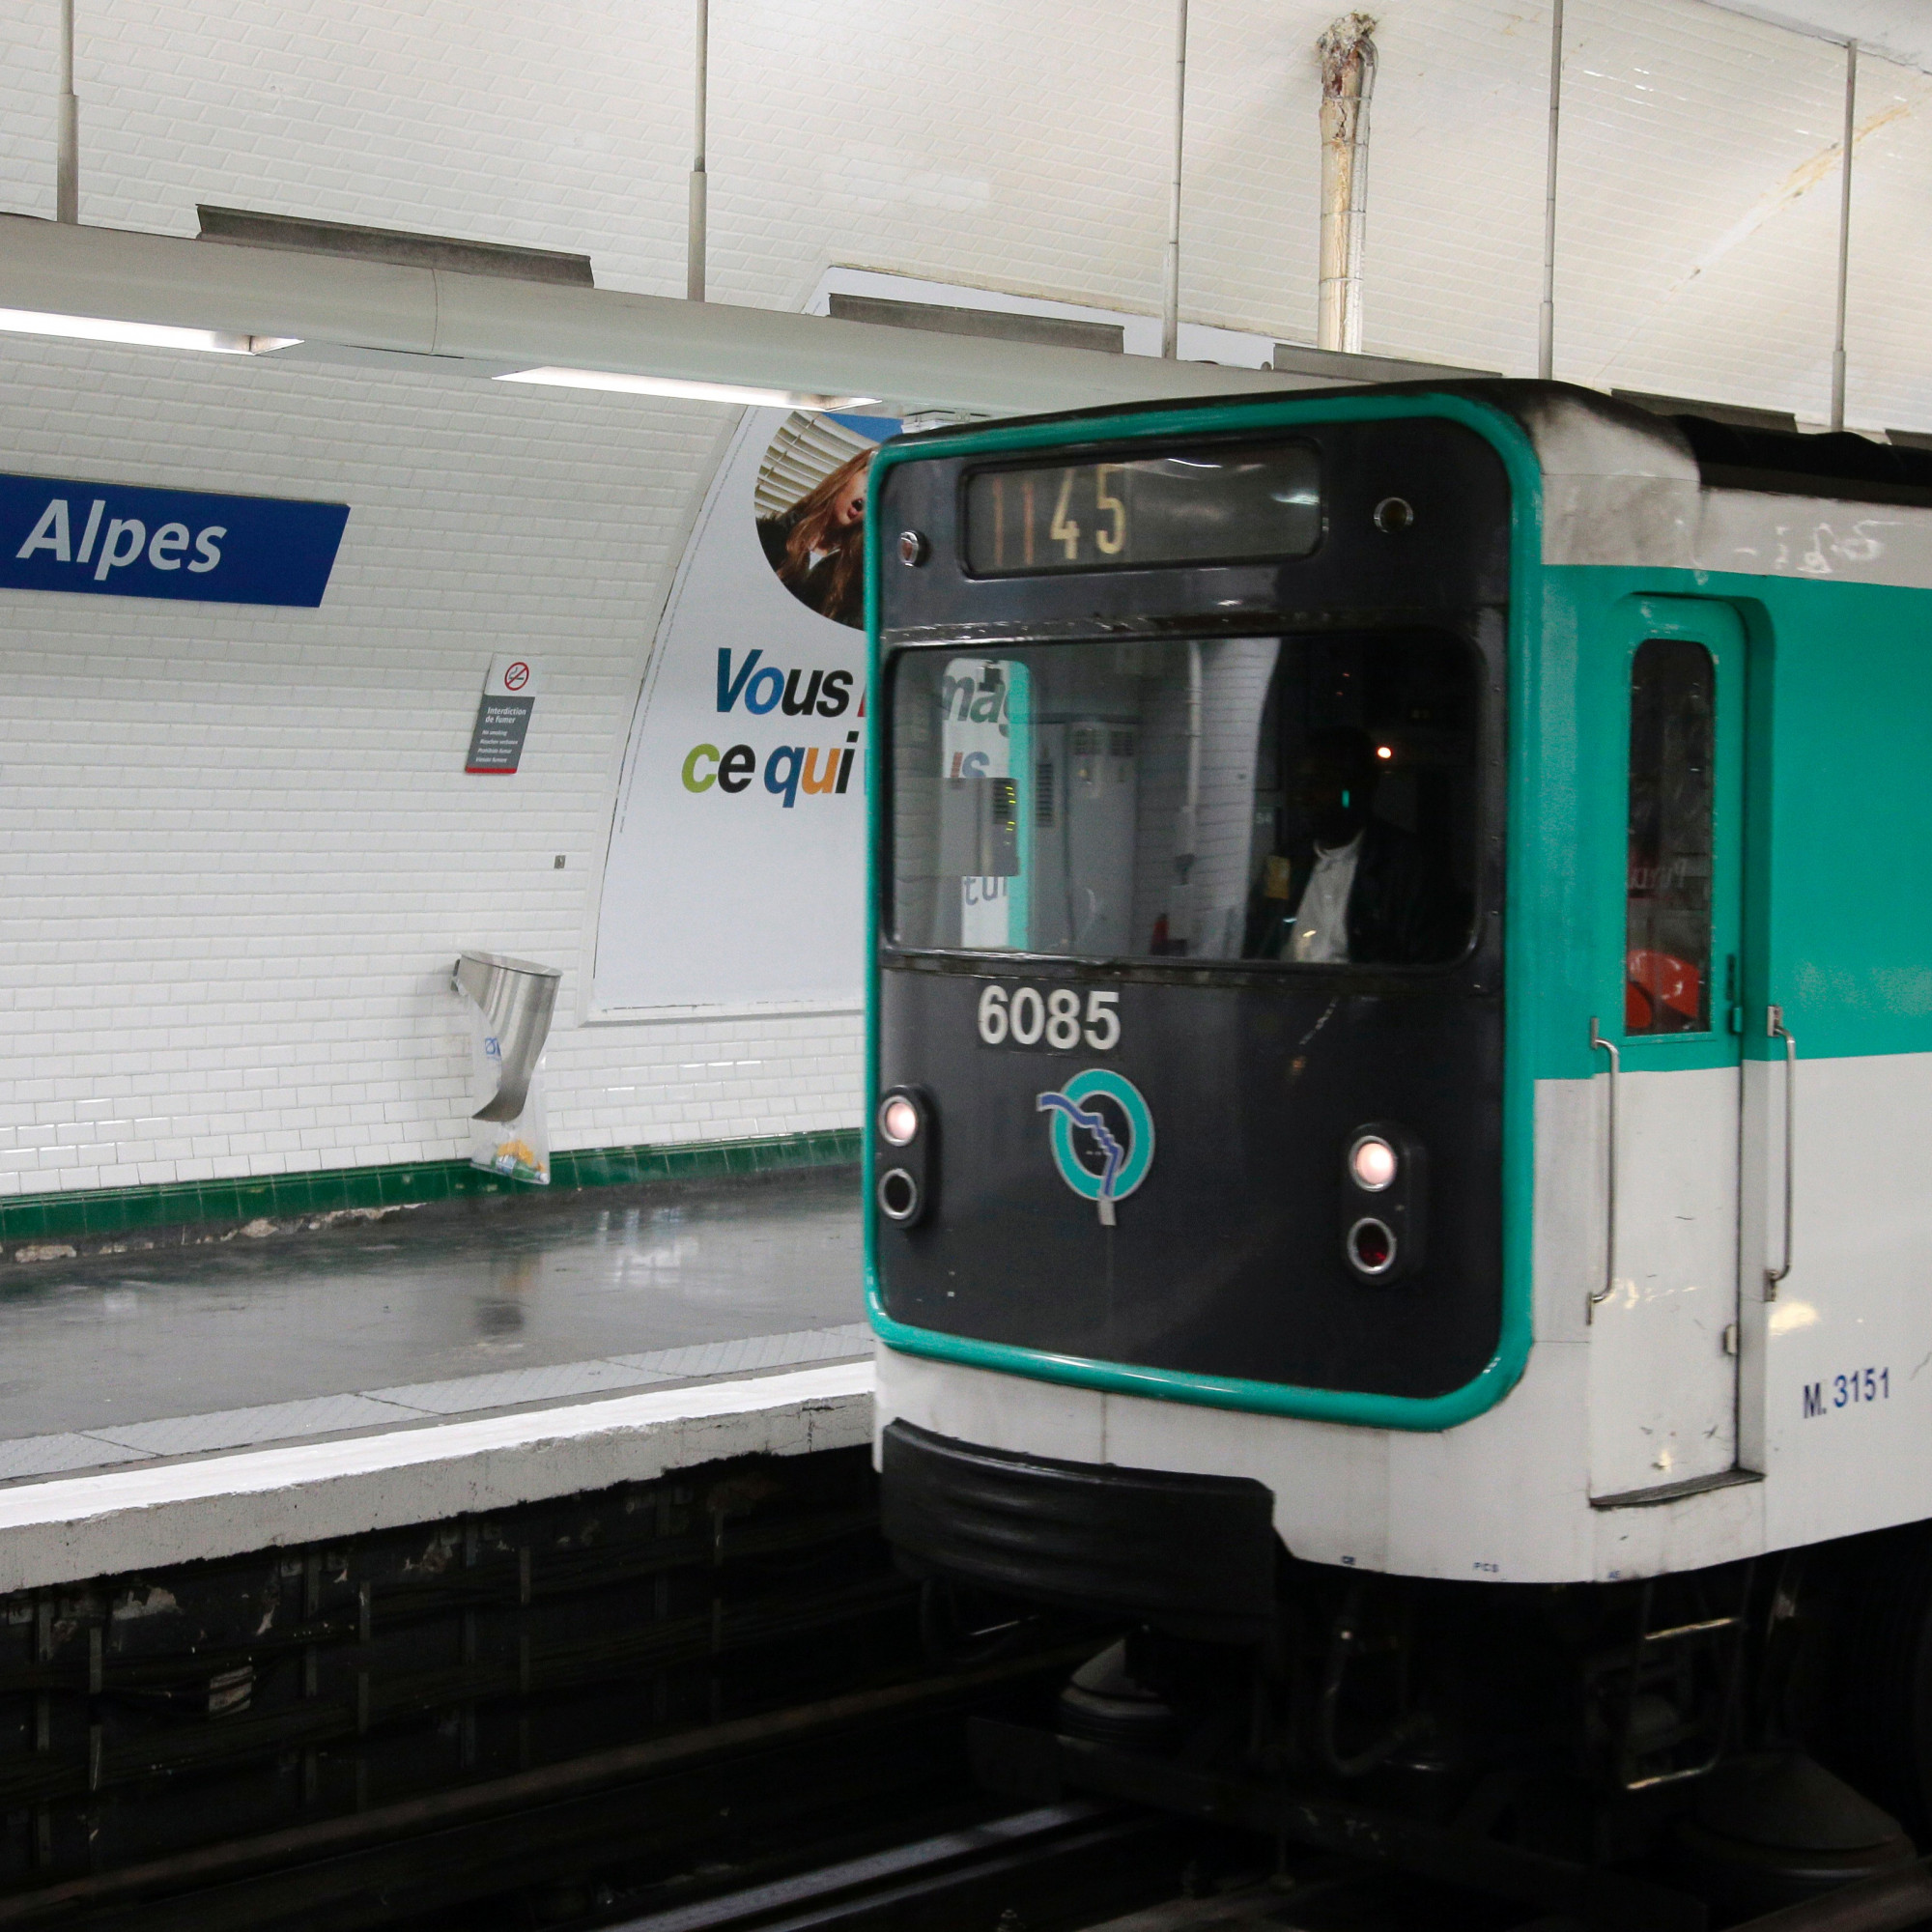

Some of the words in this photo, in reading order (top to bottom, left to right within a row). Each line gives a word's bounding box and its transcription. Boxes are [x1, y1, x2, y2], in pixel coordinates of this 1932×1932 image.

[15, 498, 227, 581] Alpes
[487, 706, 526, 716] Interdiction
[717, 647, 854, 718] Vous
[485, 715, 494, 724] de
[496, 715, 516, 724] fumer
[681, 743, 756, 793] ce
[764, 731, 860, 809] qui
[978, 984, 1121, 1050] 6085
[1833, 1367, 1889, 1408] 3151
